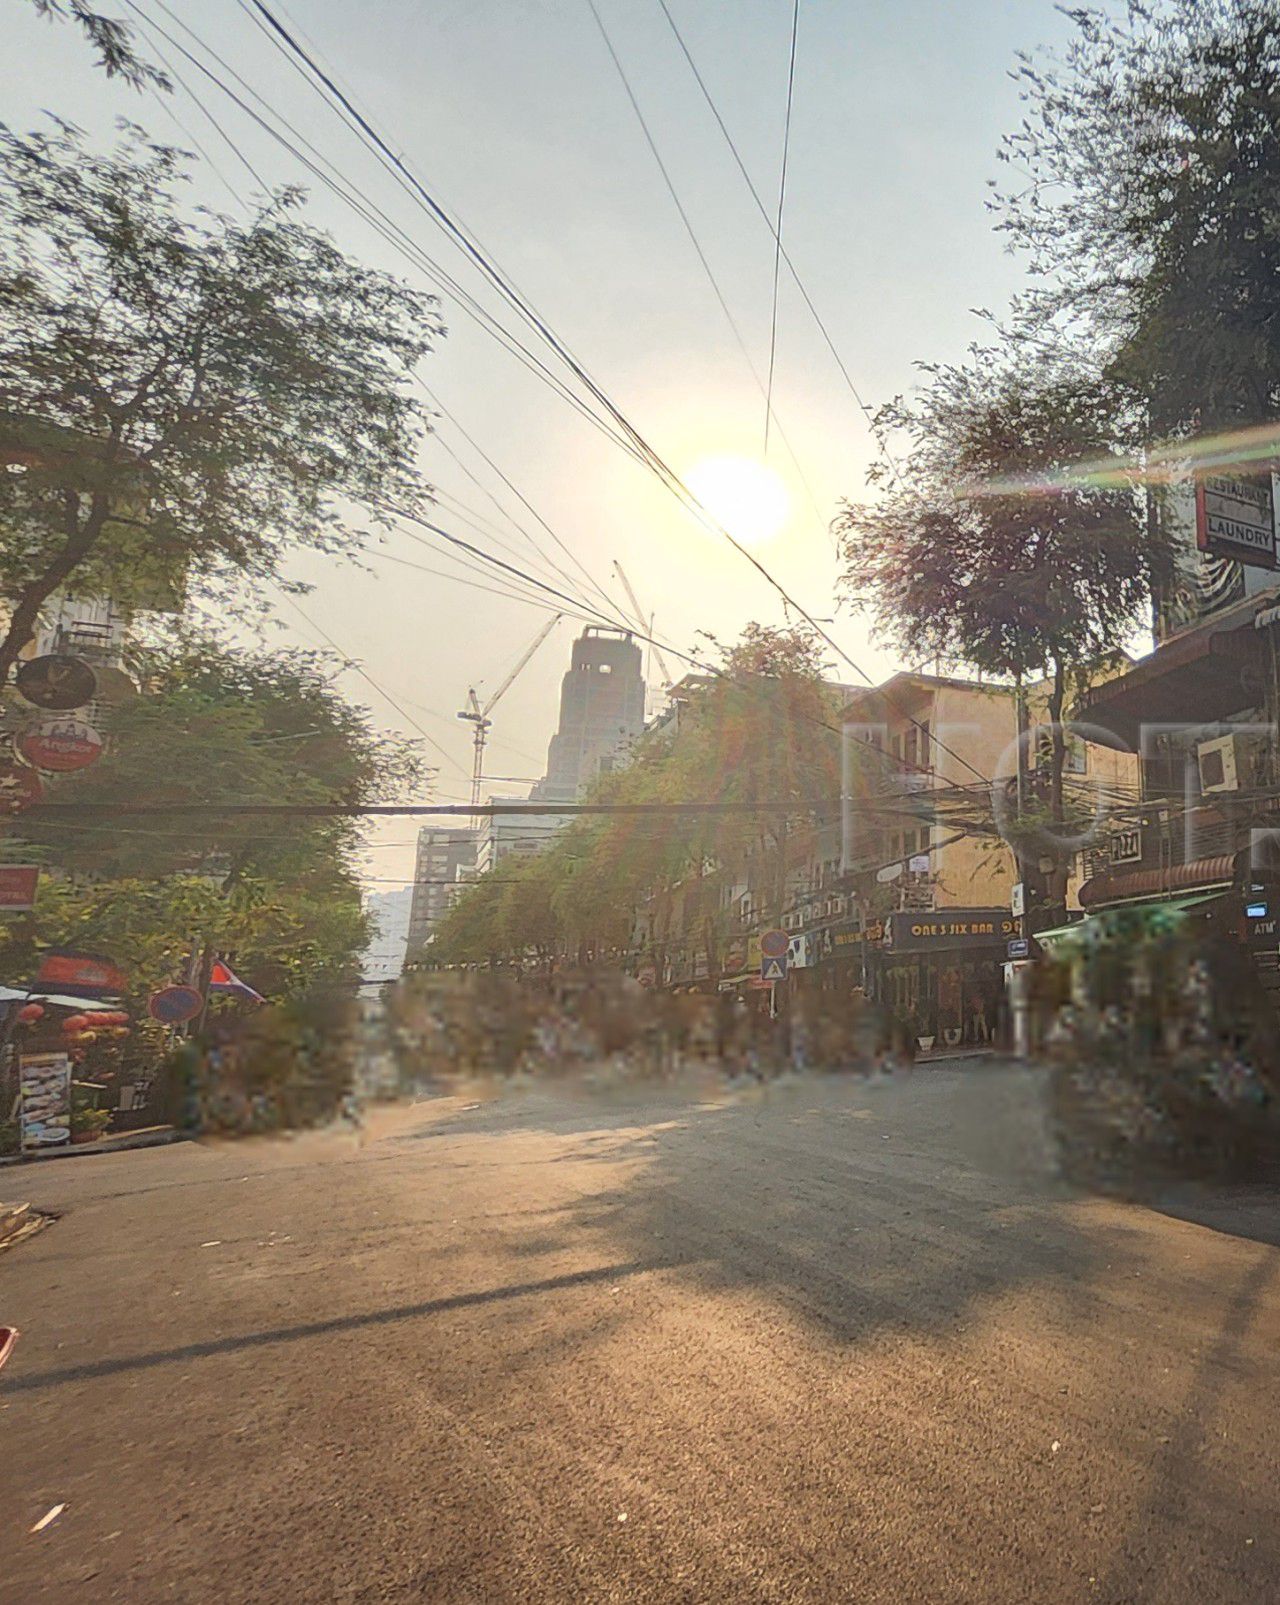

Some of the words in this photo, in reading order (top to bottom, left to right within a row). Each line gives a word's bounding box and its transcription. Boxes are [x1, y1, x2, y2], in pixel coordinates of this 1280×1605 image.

[1208, 518, 1270, 546] LAUNDRY
[911, 925, 937, 936] ONE
[949, 923, 967, 936] SIX
[971, 923, 994, 935] BAR
